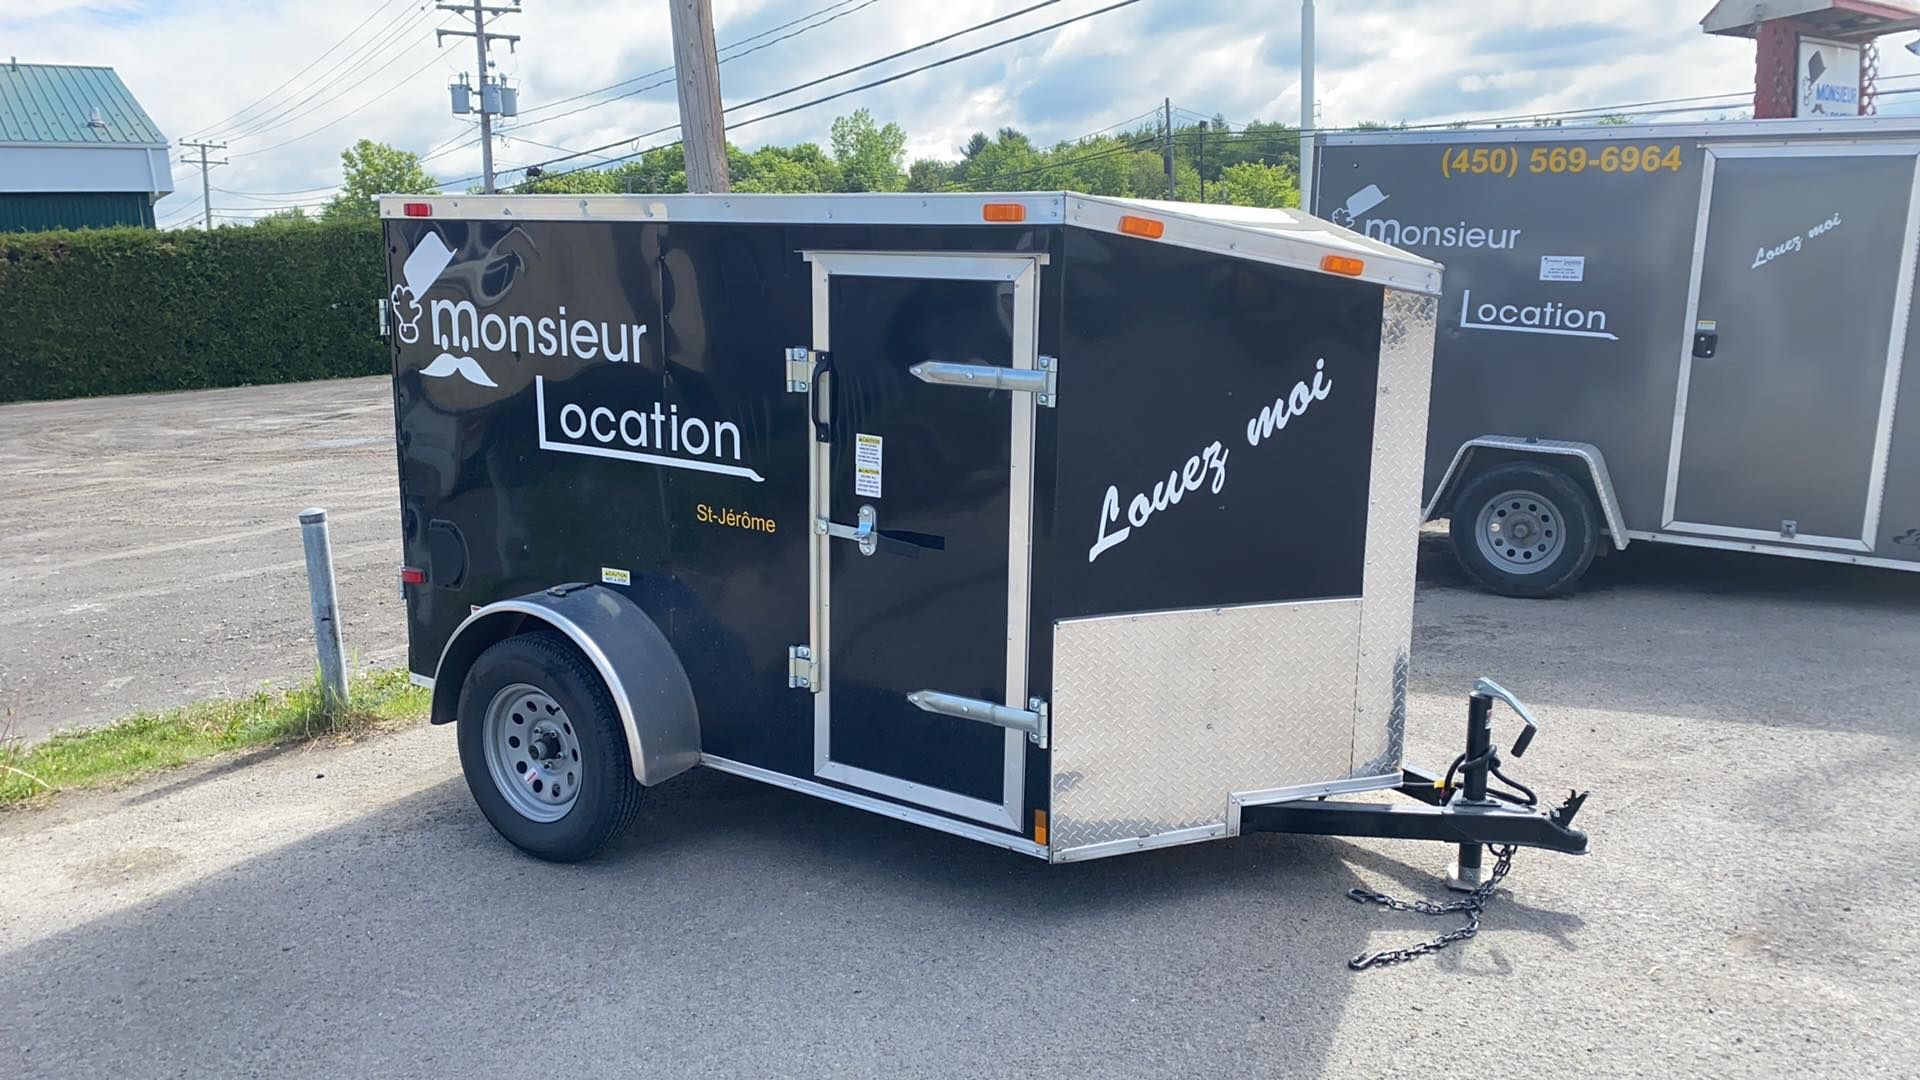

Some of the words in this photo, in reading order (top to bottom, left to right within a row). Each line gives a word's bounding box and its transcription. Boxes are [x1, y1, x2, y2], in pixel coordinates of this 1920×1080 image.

[1816, 84, 1857, 104] MONSIEUR
[1440, 146, 1519, 179] (450)
[1528, 144, 1683, 174] 569-6964
[1751, 234, 1804, 269] Louez
[1808, 212, 1842, 239] moi
[1460, 288, 1620, 341] Location
[535, 375, 766, 482] Location
[1088, 439, 1230, 563] Louez
[1246, 357, 1333, 447] moi
[696, 503, 777, 534] St-Jérôme
